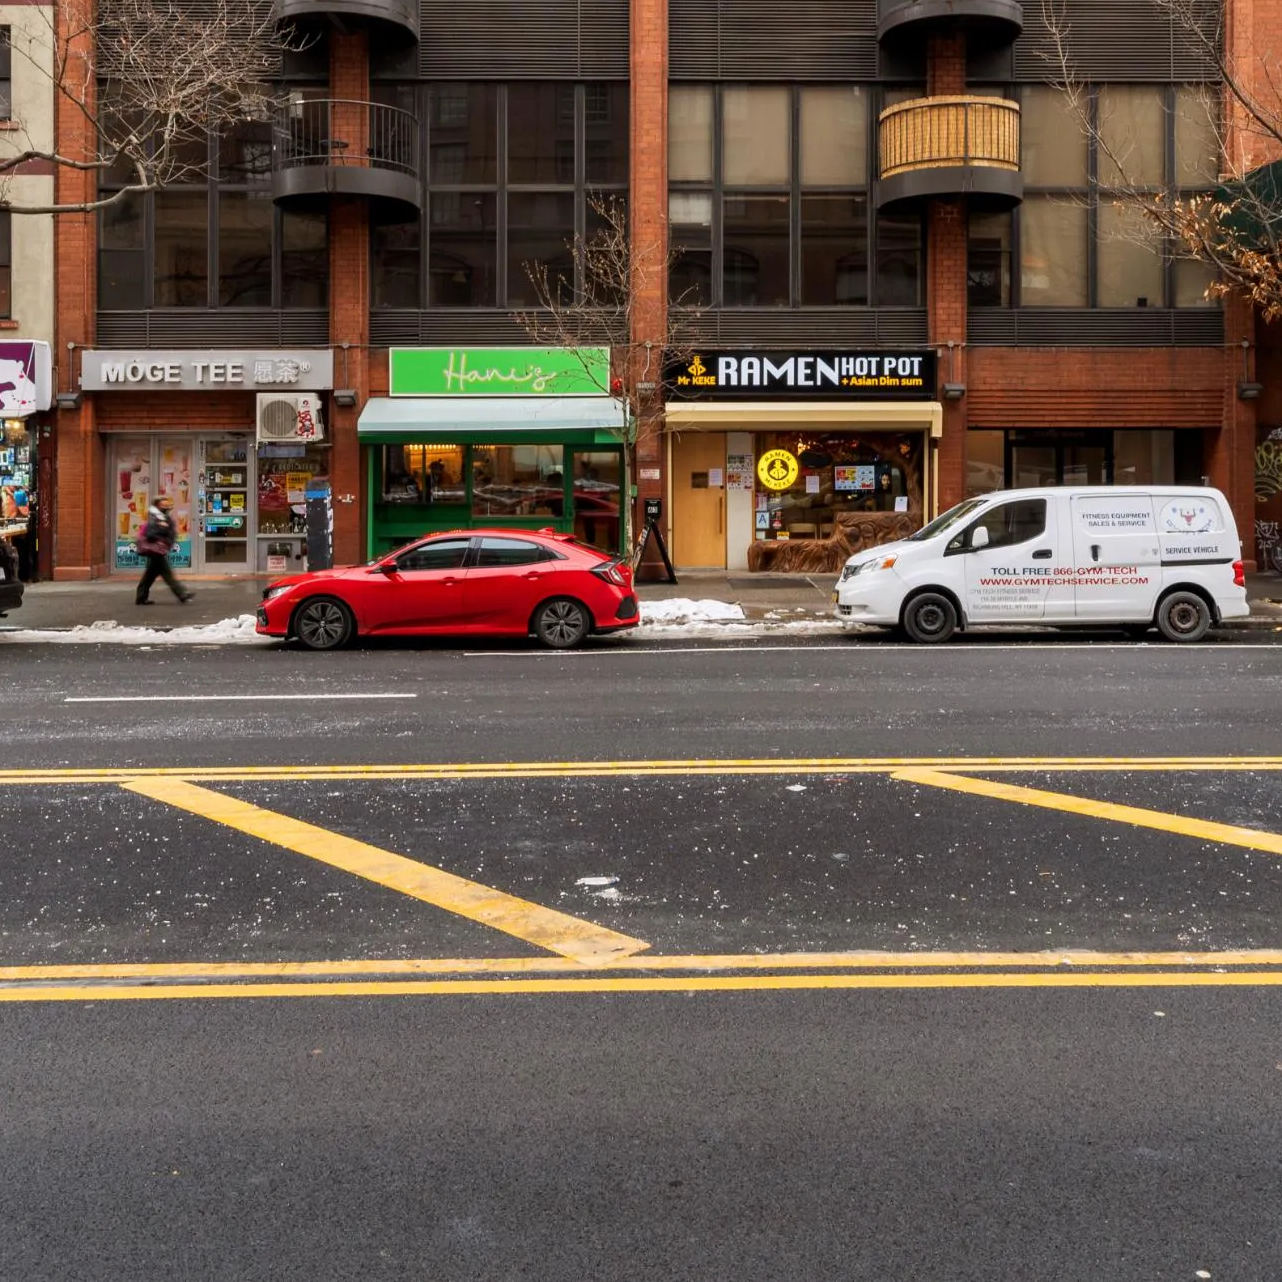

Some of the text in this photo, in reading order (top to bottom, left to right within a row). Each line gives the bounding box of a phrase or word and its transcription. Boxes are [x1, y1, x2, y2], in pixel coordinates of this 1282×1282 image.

[718, 357, 839, 386] RAMEN
[841, 357, 923, 376] HOT POT
[191, 362, 244, 383] TEE
[677, 376, 716, 385] Mr KEKE
[850, 376, 878, 386] Asian
[880, 376, 900, 386] Dim
[901, 378, 923, 386] sum
[758, 514, 767, 524] A
[1165, 546, 1218, 555] SERVICE VEHICLE
[991, 567, 1137, 576] TOLL FREE 866-GYM-TECH
[980, 577, 1149, 586] WWW.GYMTECHSERVICE.COM
